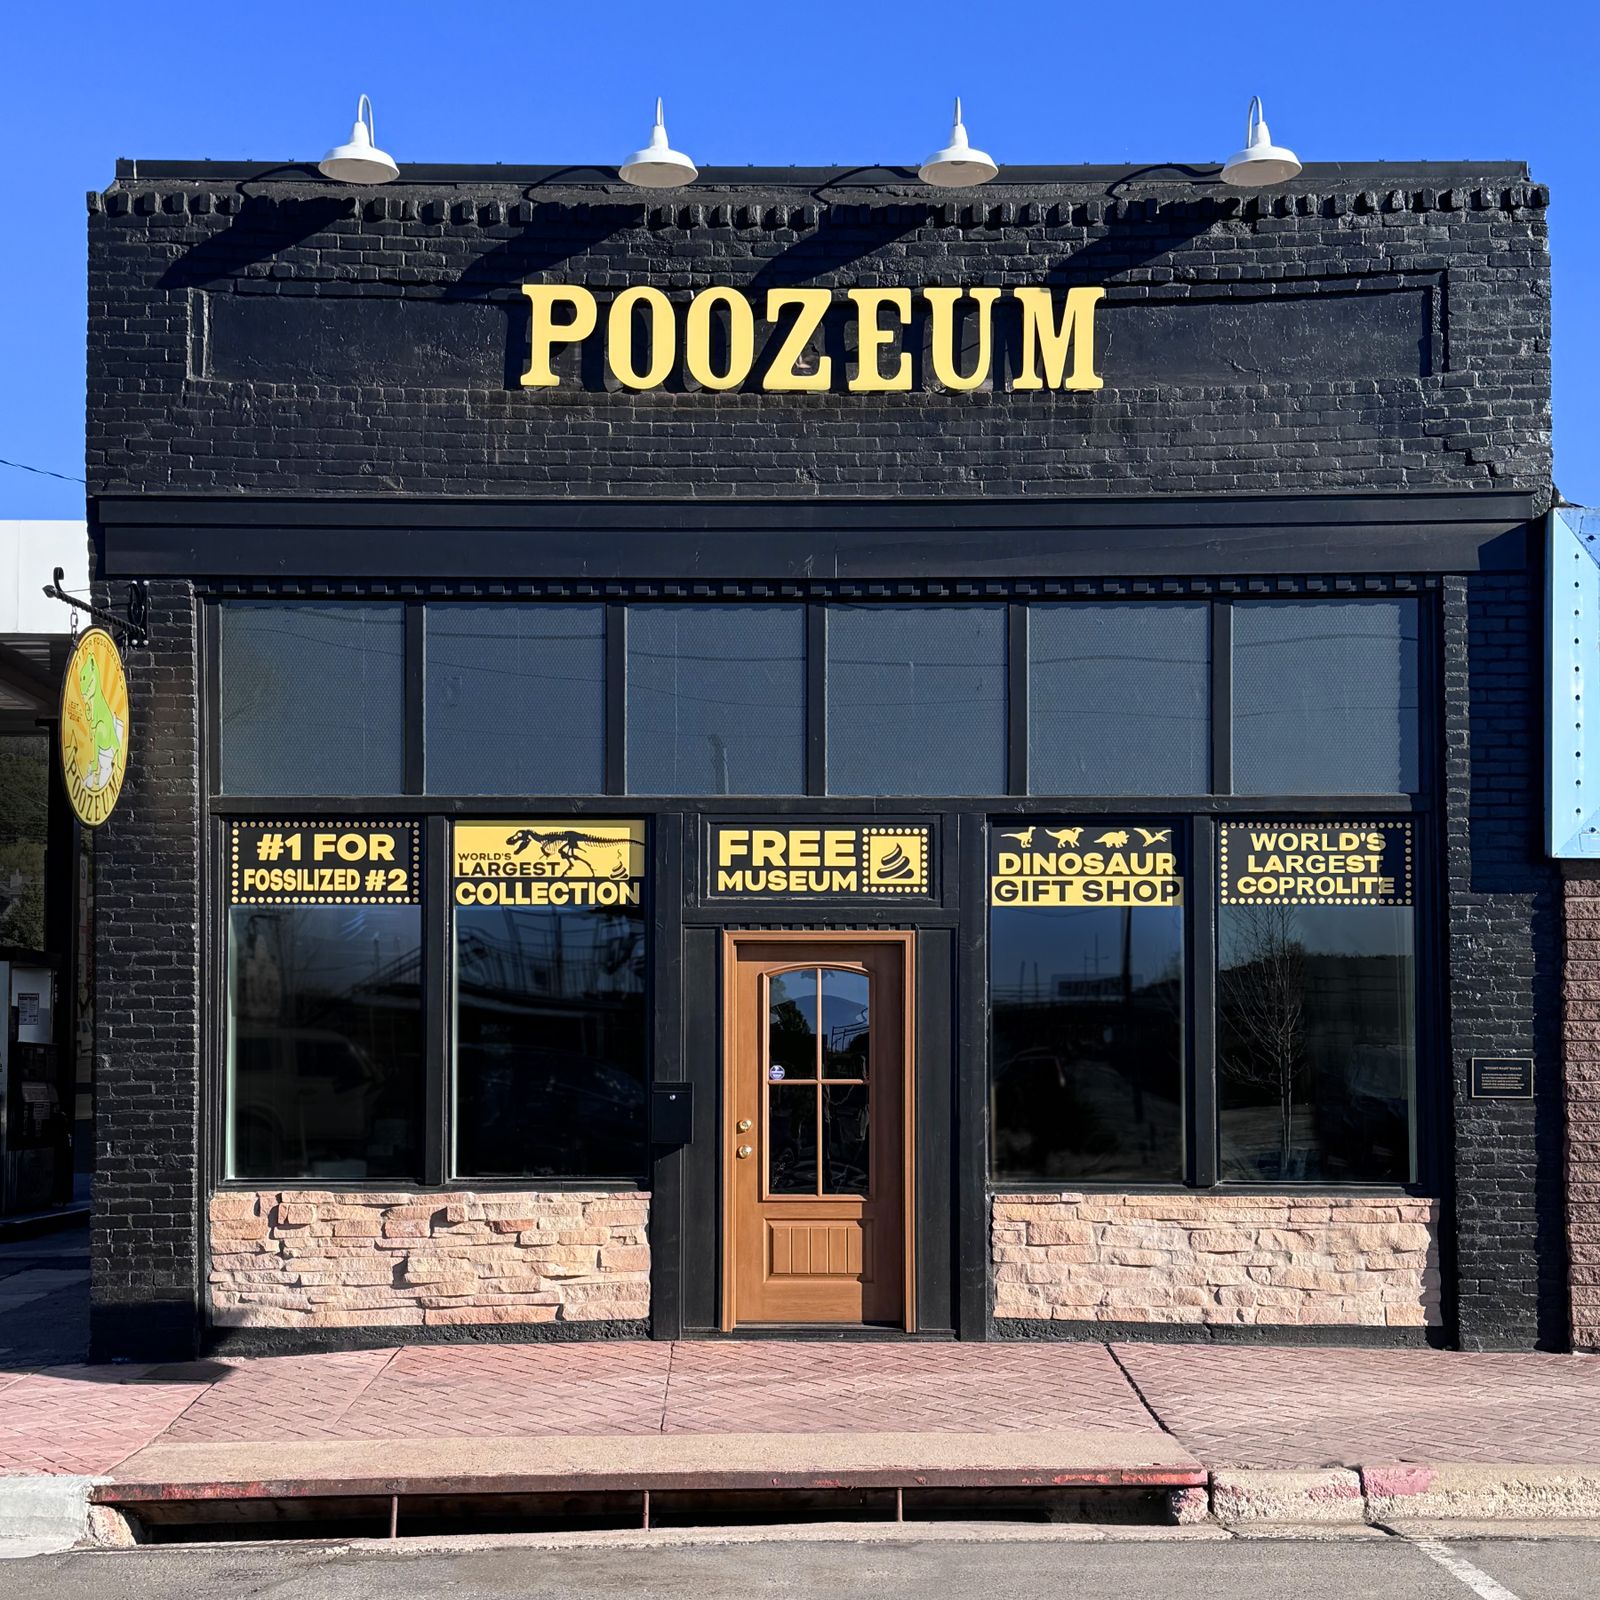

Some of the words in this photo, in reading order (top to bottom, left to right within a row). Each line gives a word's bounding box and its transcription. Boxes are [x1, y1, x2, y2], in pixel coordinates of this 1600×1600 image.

[520, 284, 1105, 391] POOZEUM
[66, 756, 120, 822] POOZEUM
[257, 833, 302, 861] #1
[314, 833, 395, 861] FOR
[719, 830, 857, 867] FREE
[1250, 832, 1387, 852] WORLD'S
[458, 852, 512, 861] WORLD'S
[998, 852, 1177, 875] DINOSAUR
[1247, 854, 1384, 874] LARGEST
[243, 868, 361, 892] FOSSILIZED
[365, 868, 407, 892] #2
[458, 862, 561, 876] LARGEST
[717, 870, 858, 892] MUSEUM
[994, 880, 1074, 903] GIFT
[1082, 880, 1181, 903] SHOP
[1236, 876, 1396, 896] COPROLITE
[455, 881, 640, 905] COLLECTION
